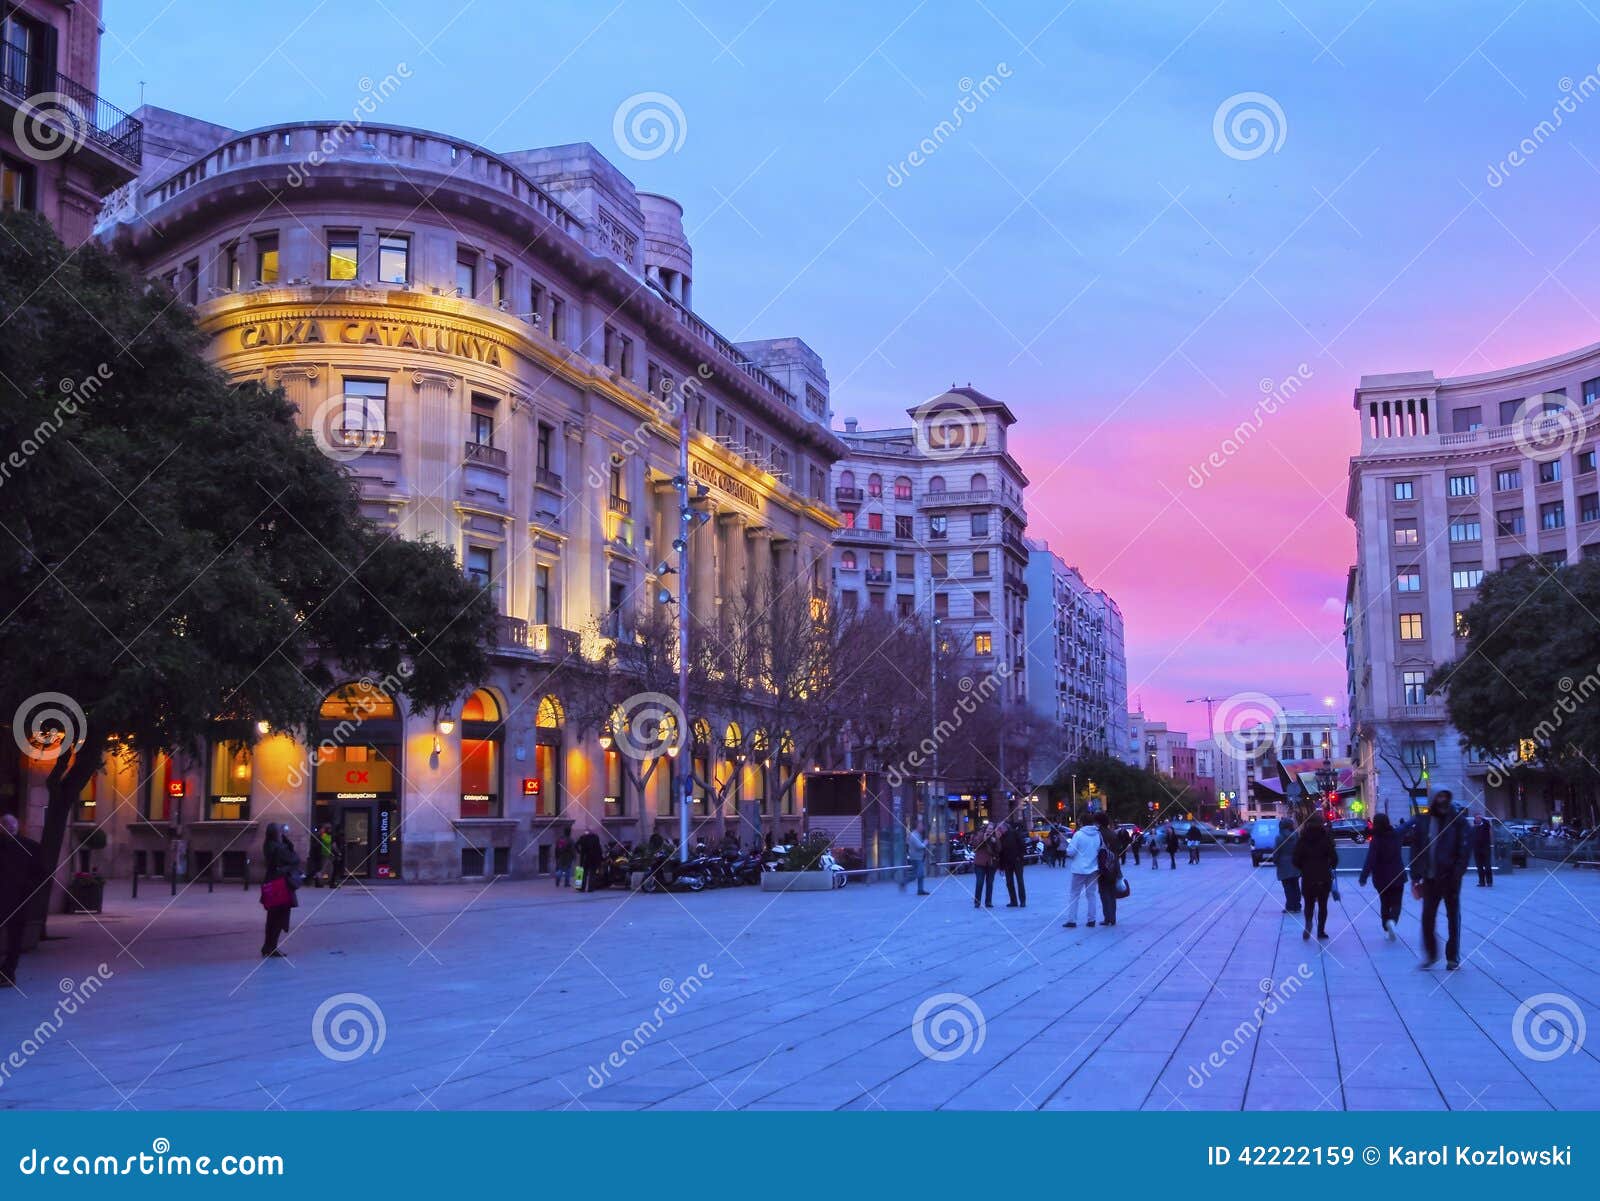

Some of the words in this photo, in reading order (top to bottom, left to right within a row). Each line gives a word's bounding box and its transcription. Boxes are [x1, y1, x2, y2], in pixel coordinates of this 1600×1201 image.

[240, 318, 326, 349] CAIXA
[339, 320, 502, 369] CATALUNYA
[345, 770, 369, 784] CX
